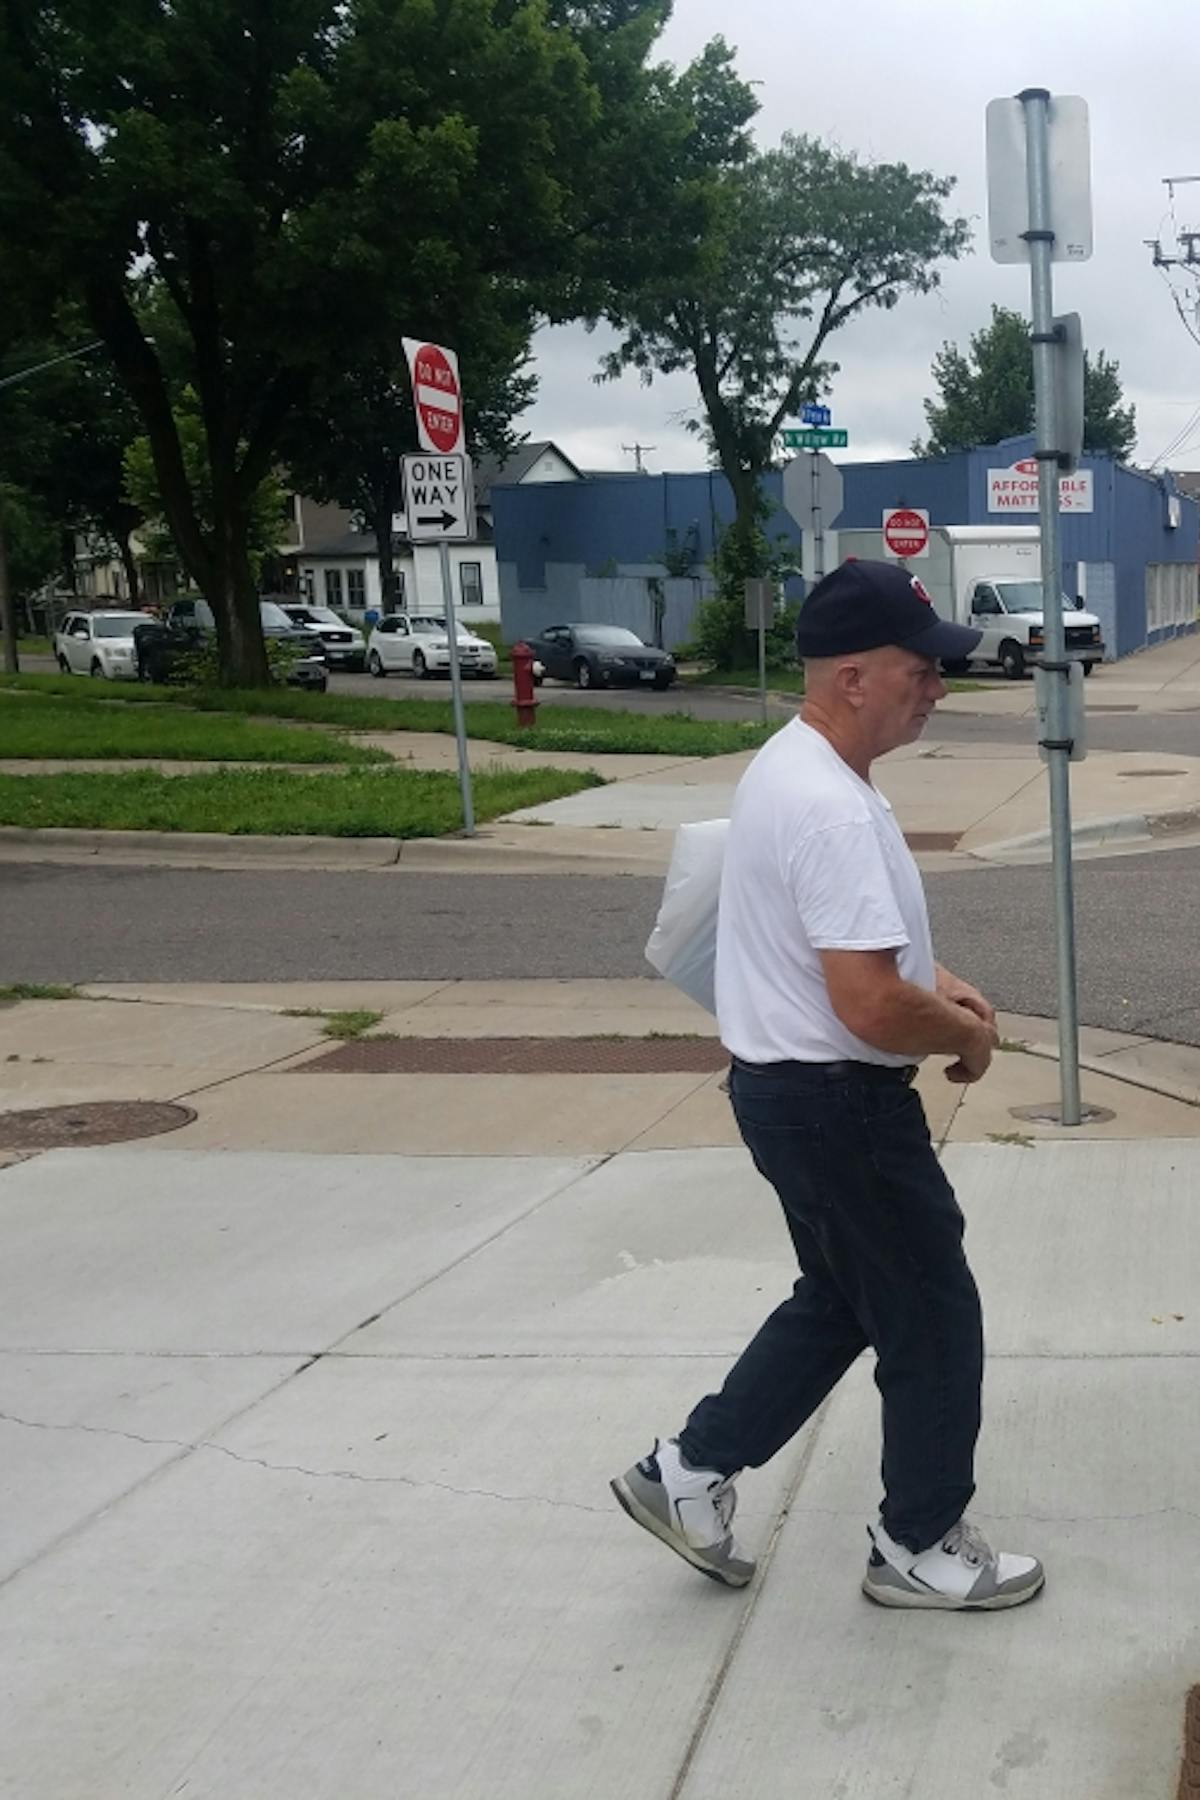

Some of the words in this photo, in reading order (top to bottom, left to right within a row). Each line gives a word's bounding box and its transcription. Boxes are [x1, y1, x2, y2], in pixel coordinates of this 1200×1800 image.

[417, 361, 432, 381] DO
[434, 367, 451, 387] NOT
[427, 411, 454, 433] ENTER
[412, 461, 457, 481] ONE
[412, 485, 458, 505] WAY
[992, 480, 1087, 492] AFFORBLE
[997, 495, 1072, 507] MATTS
